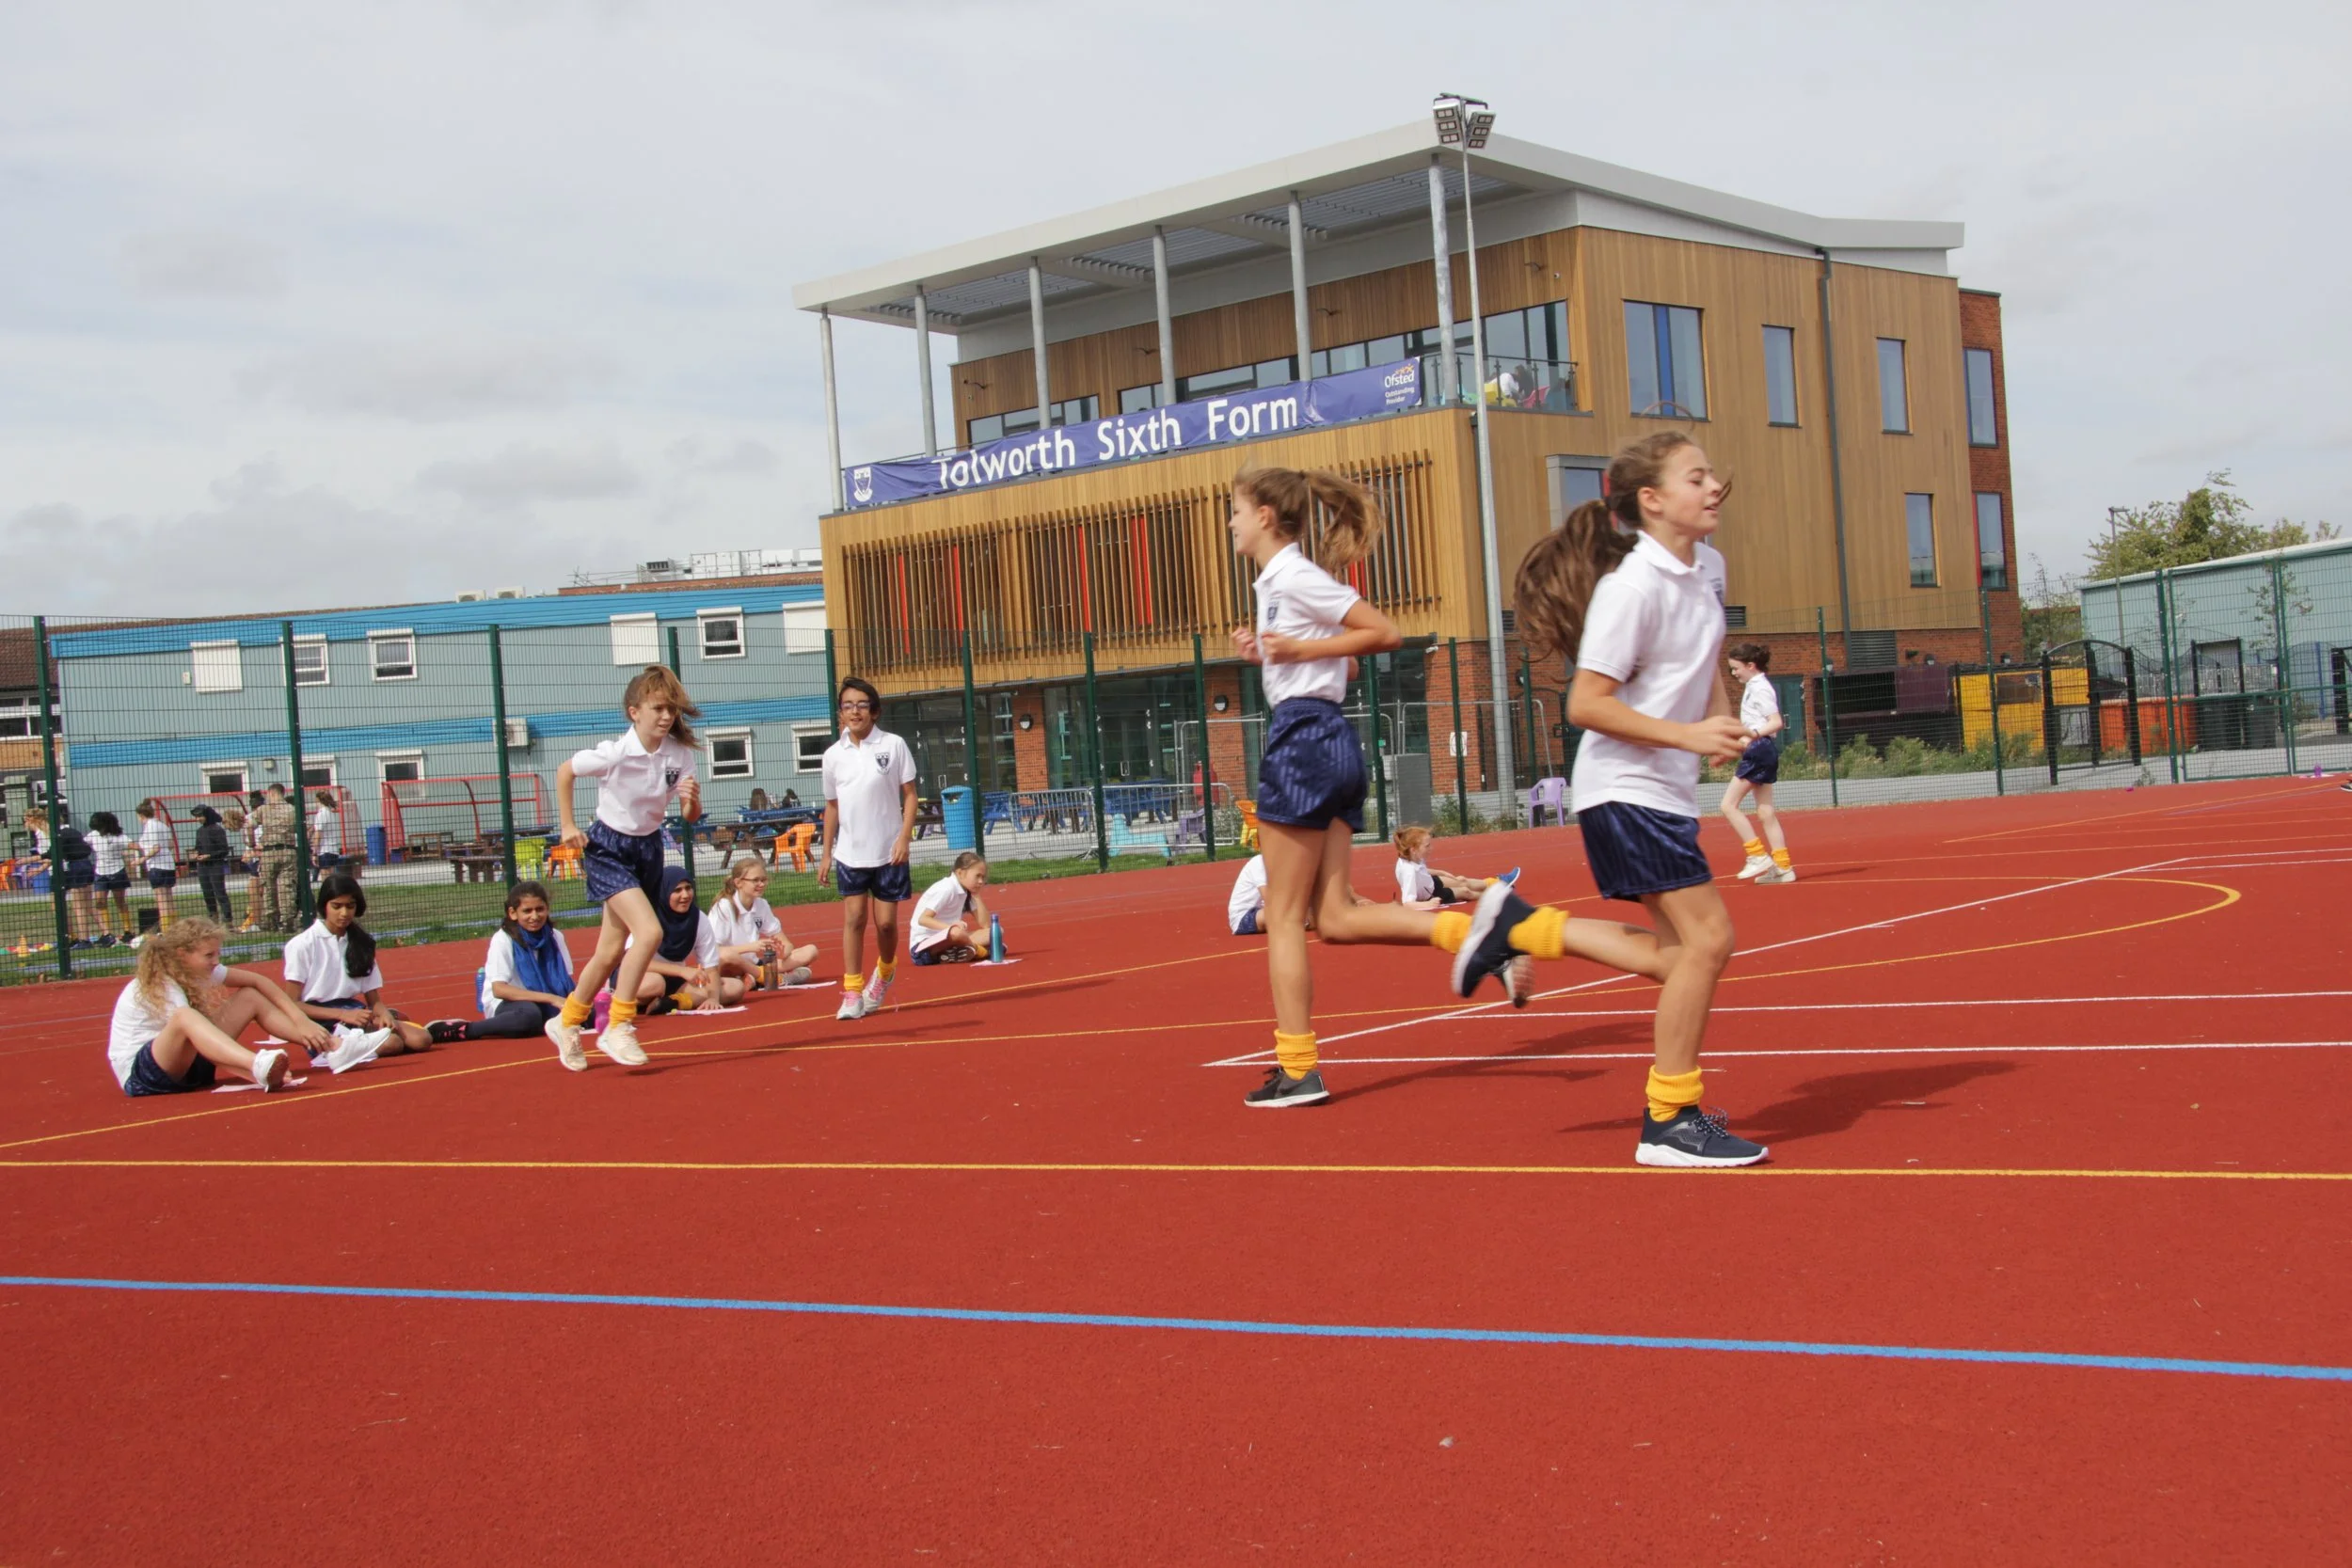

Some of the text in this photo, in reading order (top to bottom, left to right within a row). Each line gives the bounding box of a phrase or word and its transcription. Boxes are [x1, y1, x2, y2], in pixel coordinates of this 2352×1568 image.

[1384, 371, 1415, 388] Ofsted
[1097, 408, 1182, 461] Sixth
[1207, 396, 1297, 441] Form
